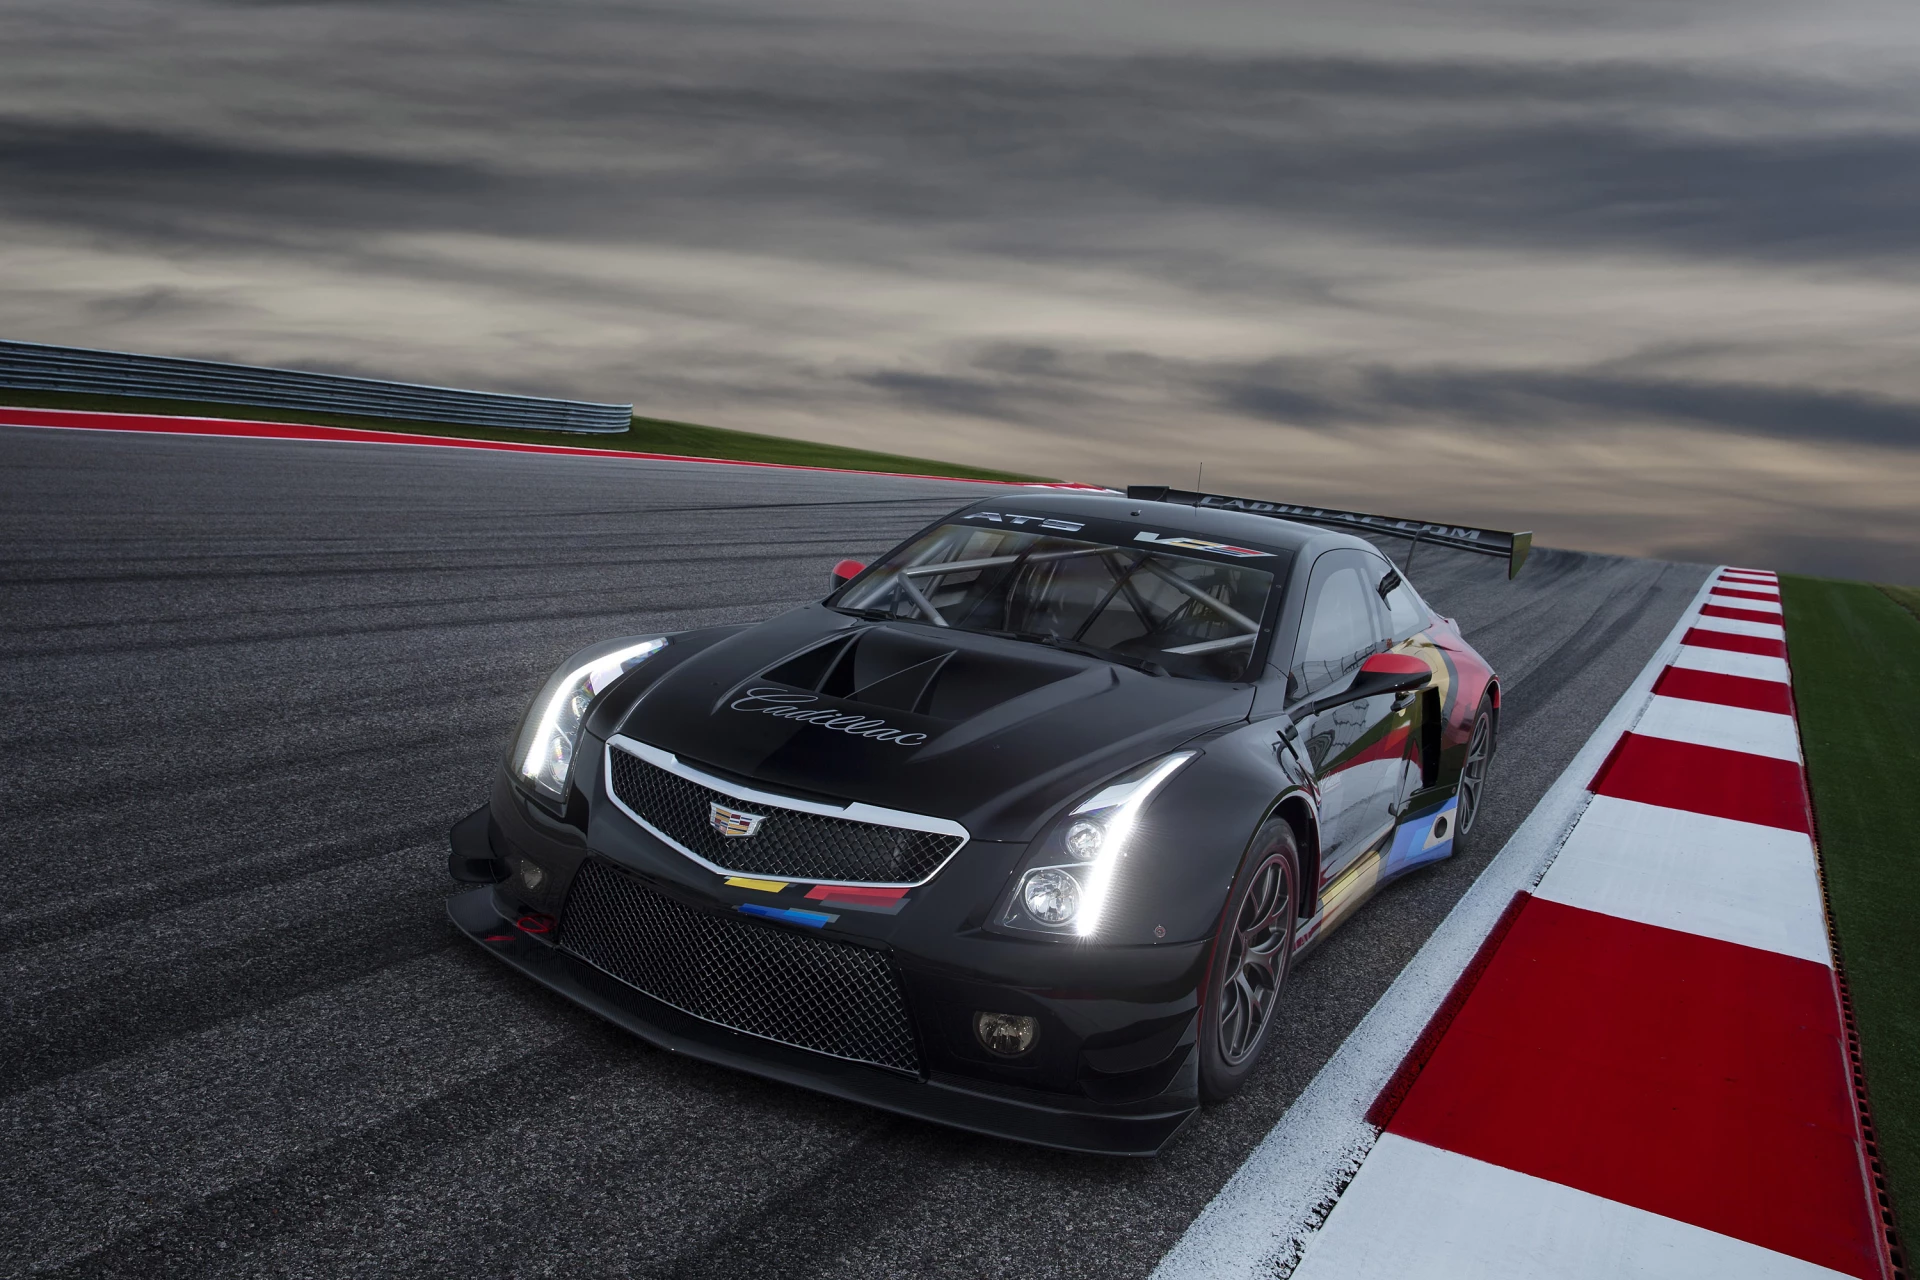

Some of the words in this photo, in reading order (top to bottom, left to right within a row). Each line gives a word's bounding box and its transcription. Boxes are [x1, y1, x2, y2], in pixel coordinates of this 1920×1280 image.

[960, 511, 1086, 532] ATS
[1200, 496, 1481, 540] CADILLAC.COM
[730, 687, 927, 745] Cadillac
